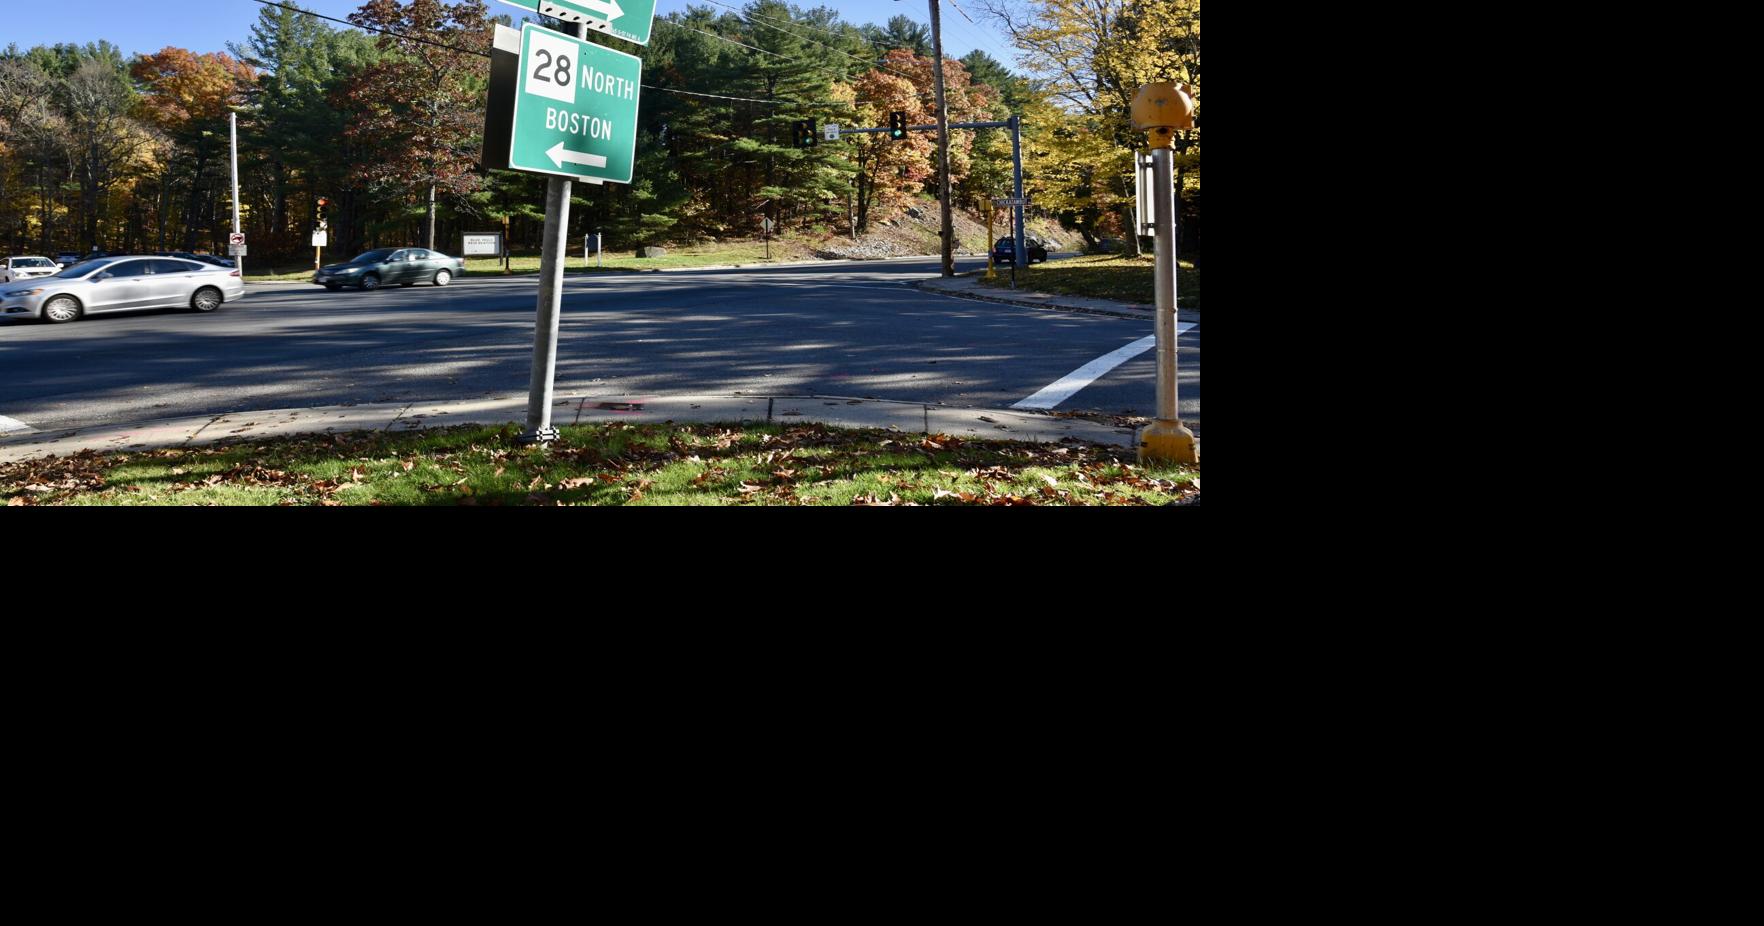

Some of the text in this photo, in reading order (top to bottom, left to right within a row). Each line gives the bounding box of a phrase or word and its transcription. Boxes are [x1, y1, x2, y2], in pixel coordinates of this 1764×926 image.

[533, 48, 634, 101] 28 NORTH
[545, 107, 612, 141] BOSTON
